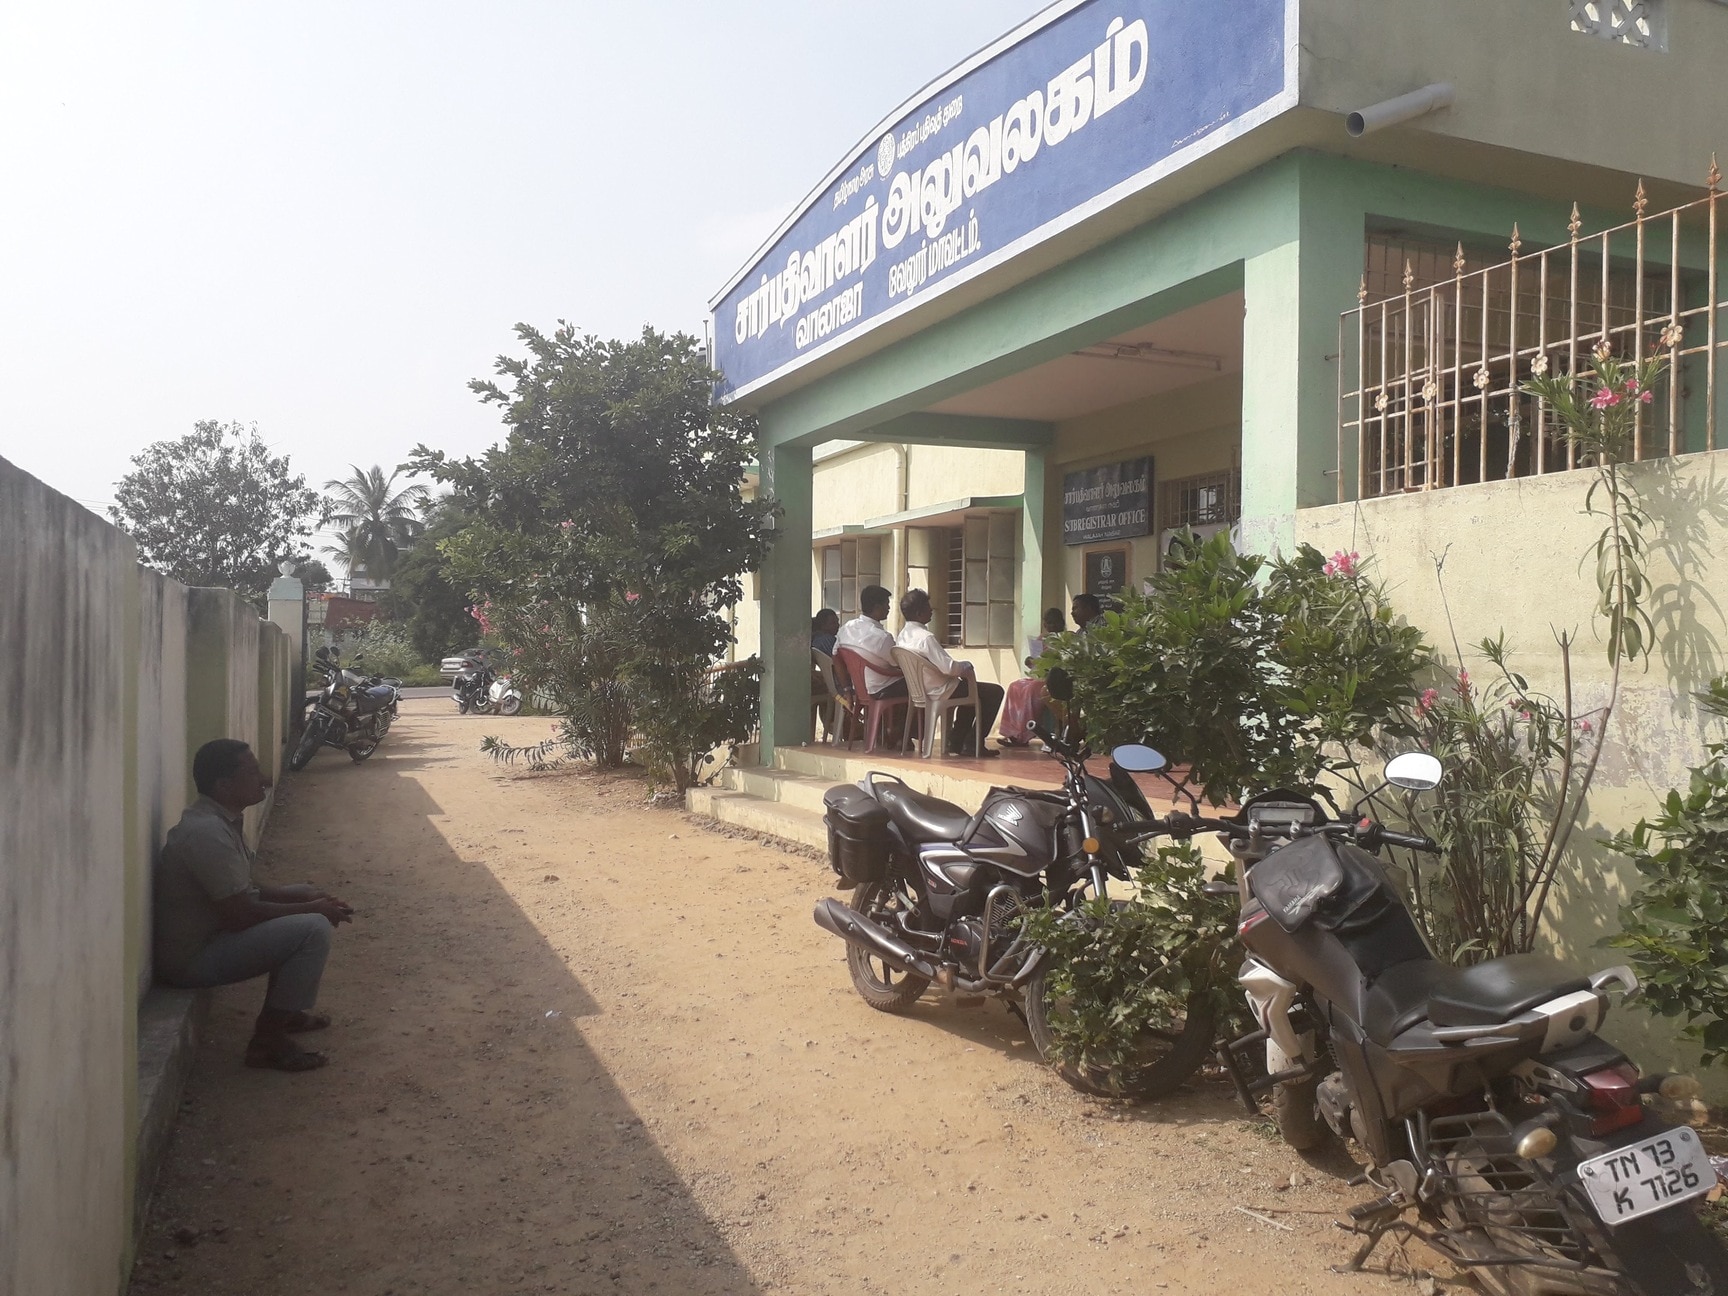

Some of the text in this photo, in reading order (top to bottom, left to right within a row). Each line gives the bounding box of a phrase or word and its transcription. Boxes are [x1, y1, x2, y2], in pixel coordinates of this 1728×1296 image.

[735, 16, 1149, 345] சார்பதிவாளர் அலுவலகம்
[888, 239, 928, 298] வேலூர்
[795, 281, 863, 350] வாலாஜா
[1118, 508, 1146, 526] OFFICE
[1283, 895, 1302, 913] YAMAHA
[1604, 1139, 1675, 1182] TN 73
[1613, 1162, 1699, 1214] K 7126
